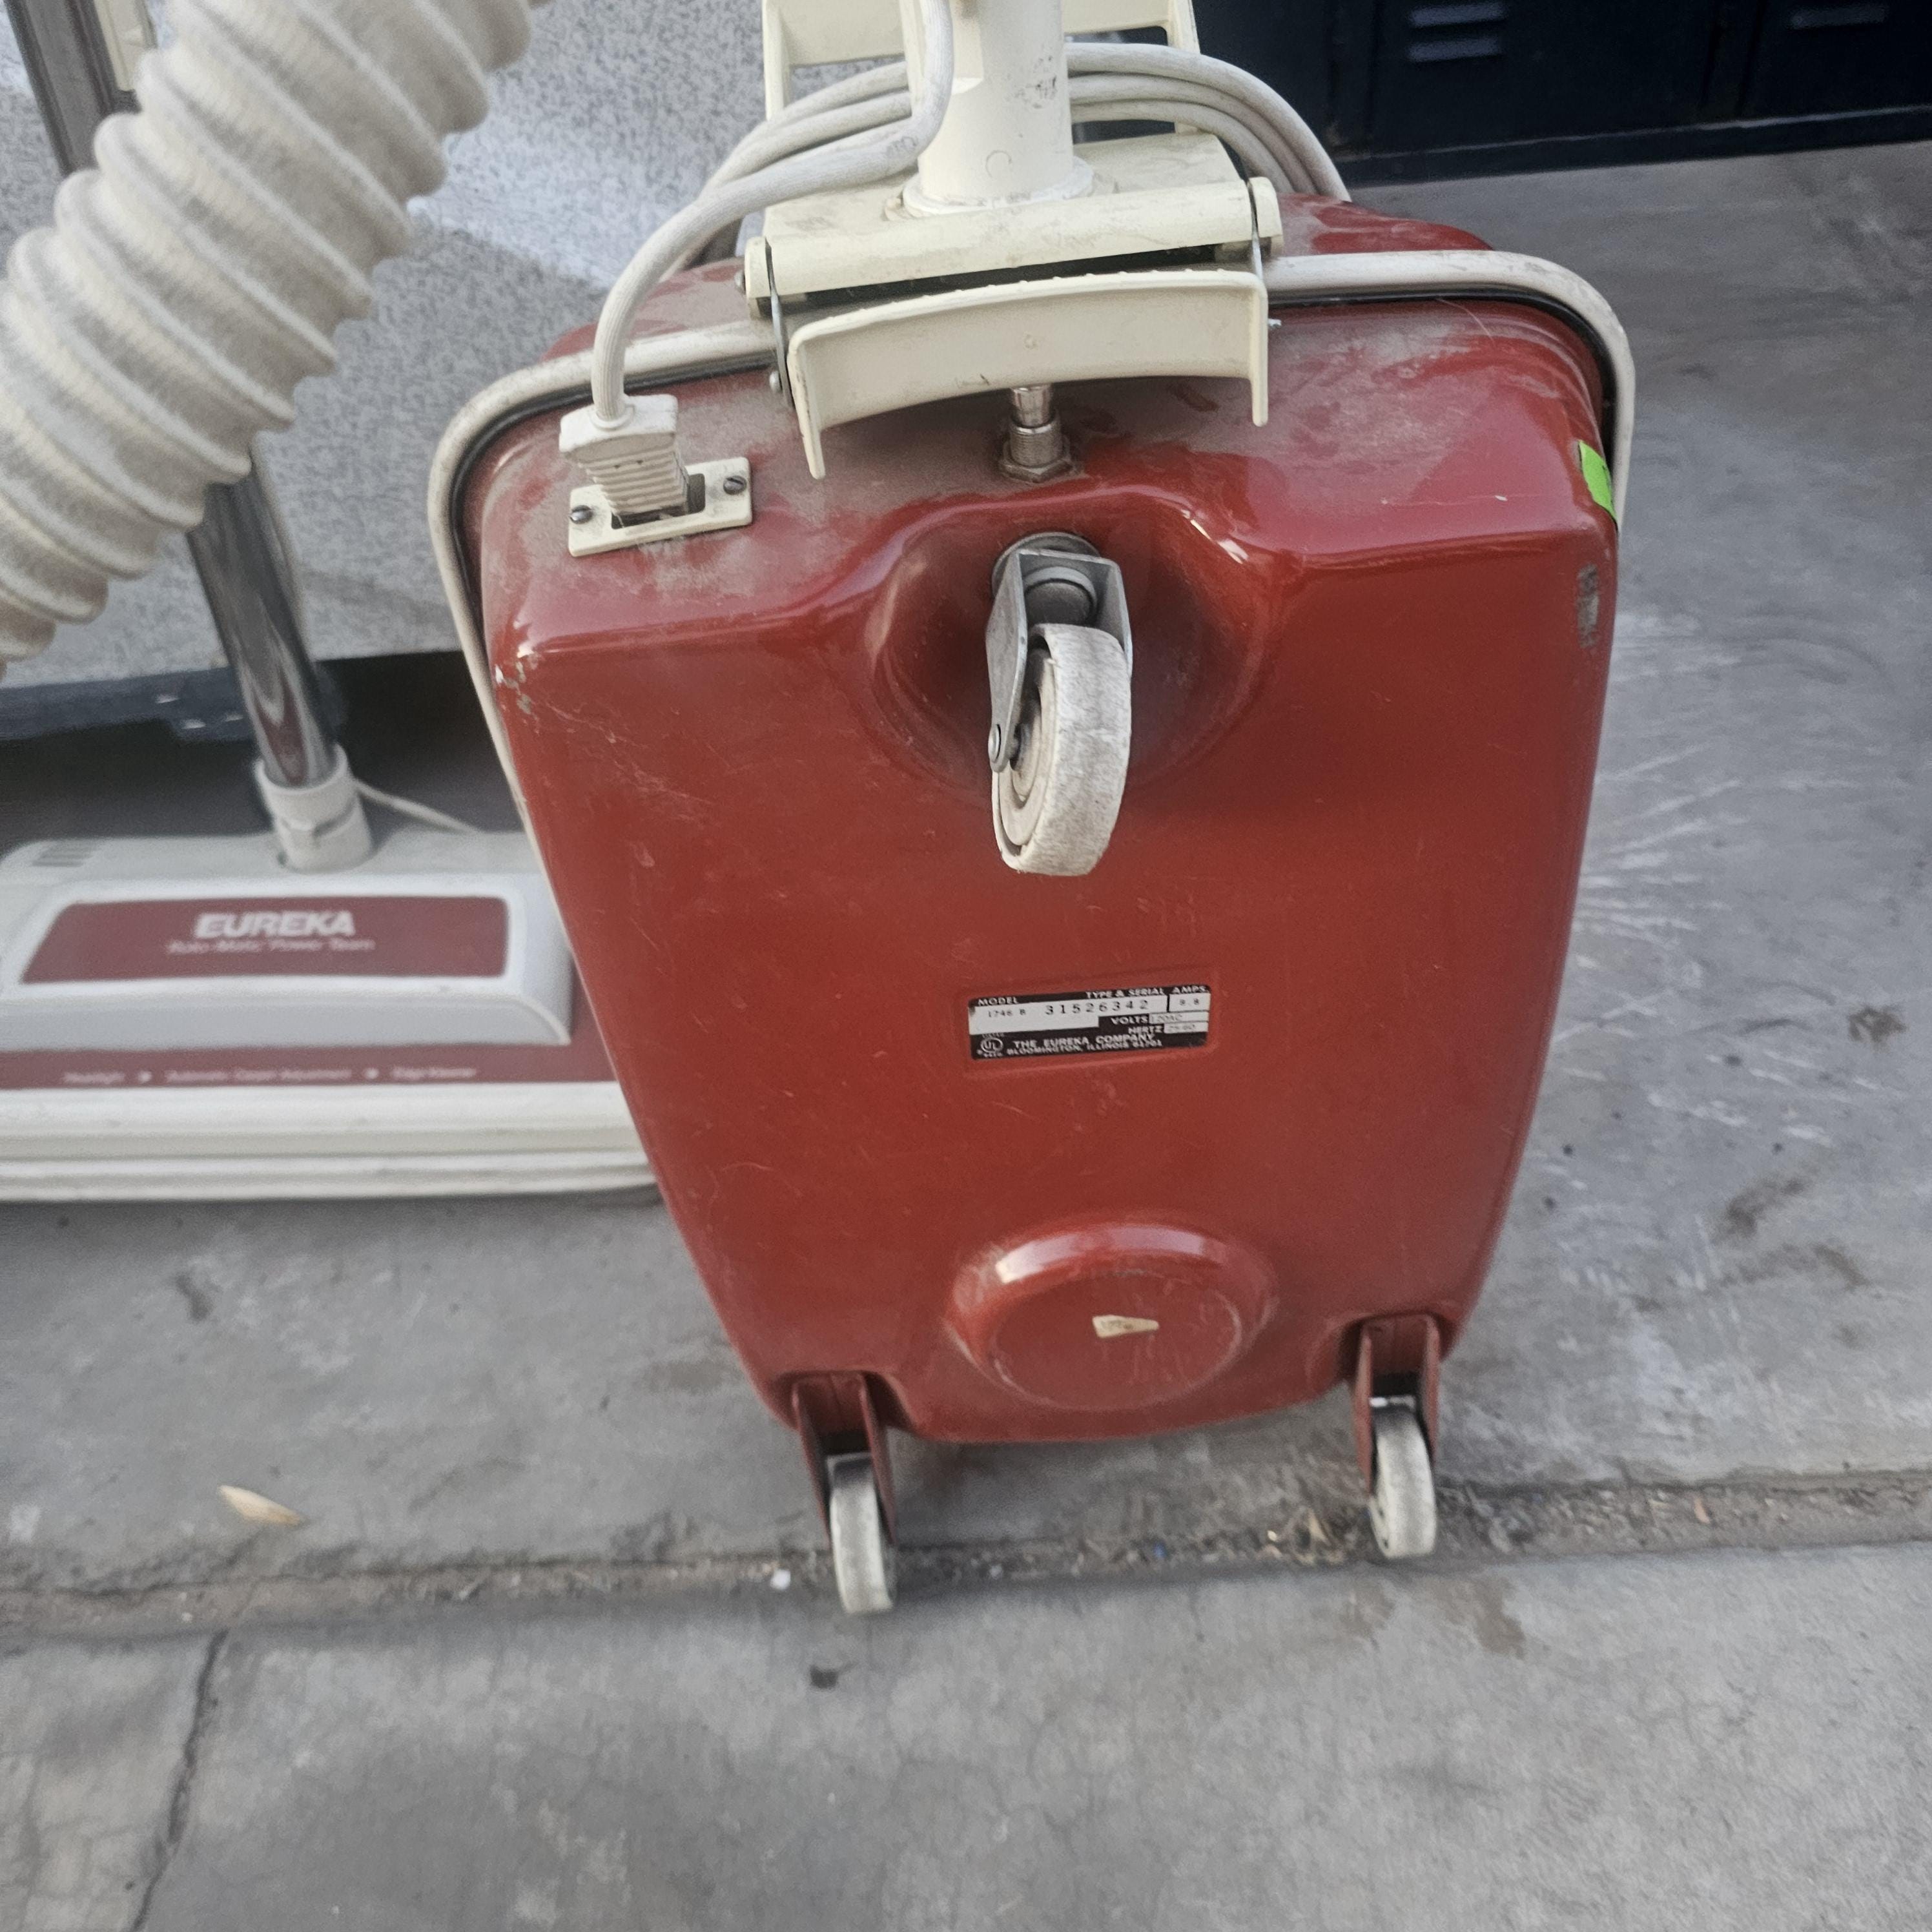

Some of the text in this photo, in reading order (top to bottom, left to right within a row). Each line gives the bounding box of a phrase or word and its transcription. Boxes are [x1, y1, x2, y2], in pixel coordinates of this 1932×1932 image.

[196, 910, 355, 938] EUREKA
[1085, 991, 1113, 999] TYPE
[1128, 987, 1165, 996] SERIAL
[1171, 985, 1206, 994] AMPS
[978, 996, 1018, 1006] MODEL
[1111, 1016, 1148, 1025] VOLTS
[1012, 1039, 1038, 1049] THE
[1043, 1036, 1089, 1047] EUREKA
